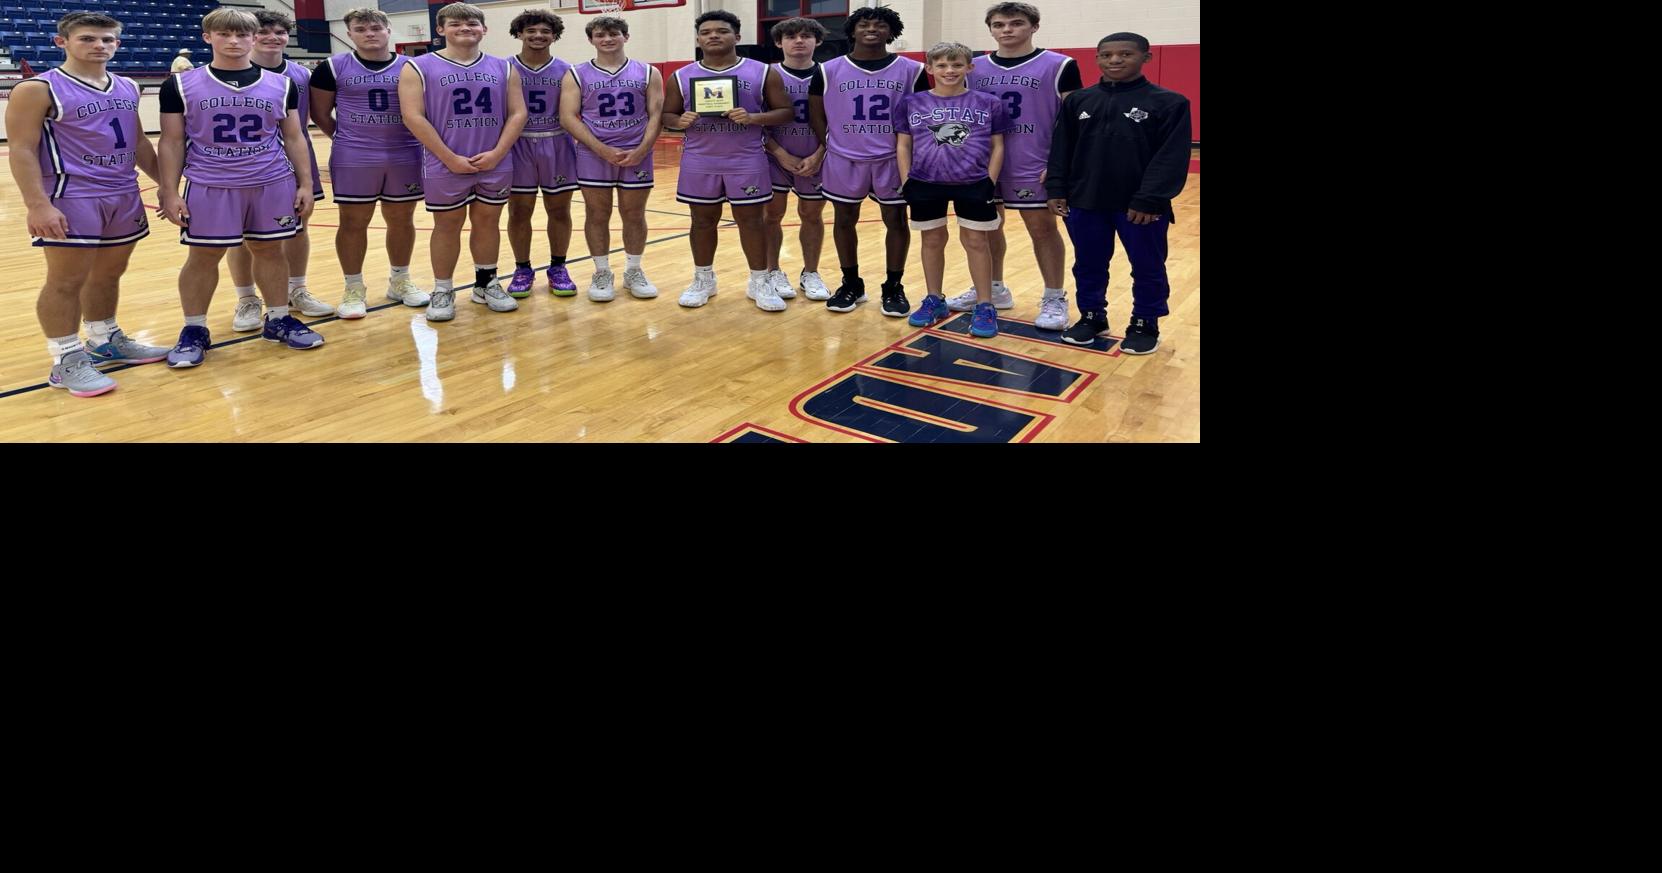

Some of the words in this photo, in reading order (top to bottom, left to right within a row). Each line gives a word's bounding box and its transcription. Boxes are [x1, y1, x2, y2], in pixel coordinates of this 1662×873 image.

[345, 74, 399, 87] COLLEG
[440, 72, 498, 87] COLLEGE
[588, 79, 640, 91] COLLEGE
[839, 80, 904, 93] COLLEGE
[975, 75, 1040, 90] COLLEGE
[76, 98, 138, 119] COLLEGE
[200, 96, 274, 113] COLLEGE
[368, 88, 390, 112] 0
[452, 87, 493, 115] 24
[528, 90, 547, 114] 5
[597, 92, 635, 117] 23
[852, 94, 890, 121] 12
[350, 113, 402, 125] STATIO
[446, 117, 499, 129] STATION
[910, 106, 990, 127] C-STAT
[108, 117, 128, 150] 1
[212, 113, 264, 144] 22
[694, 122, 747, 133] STATION
[842, 124, 896, 134] STATIO
